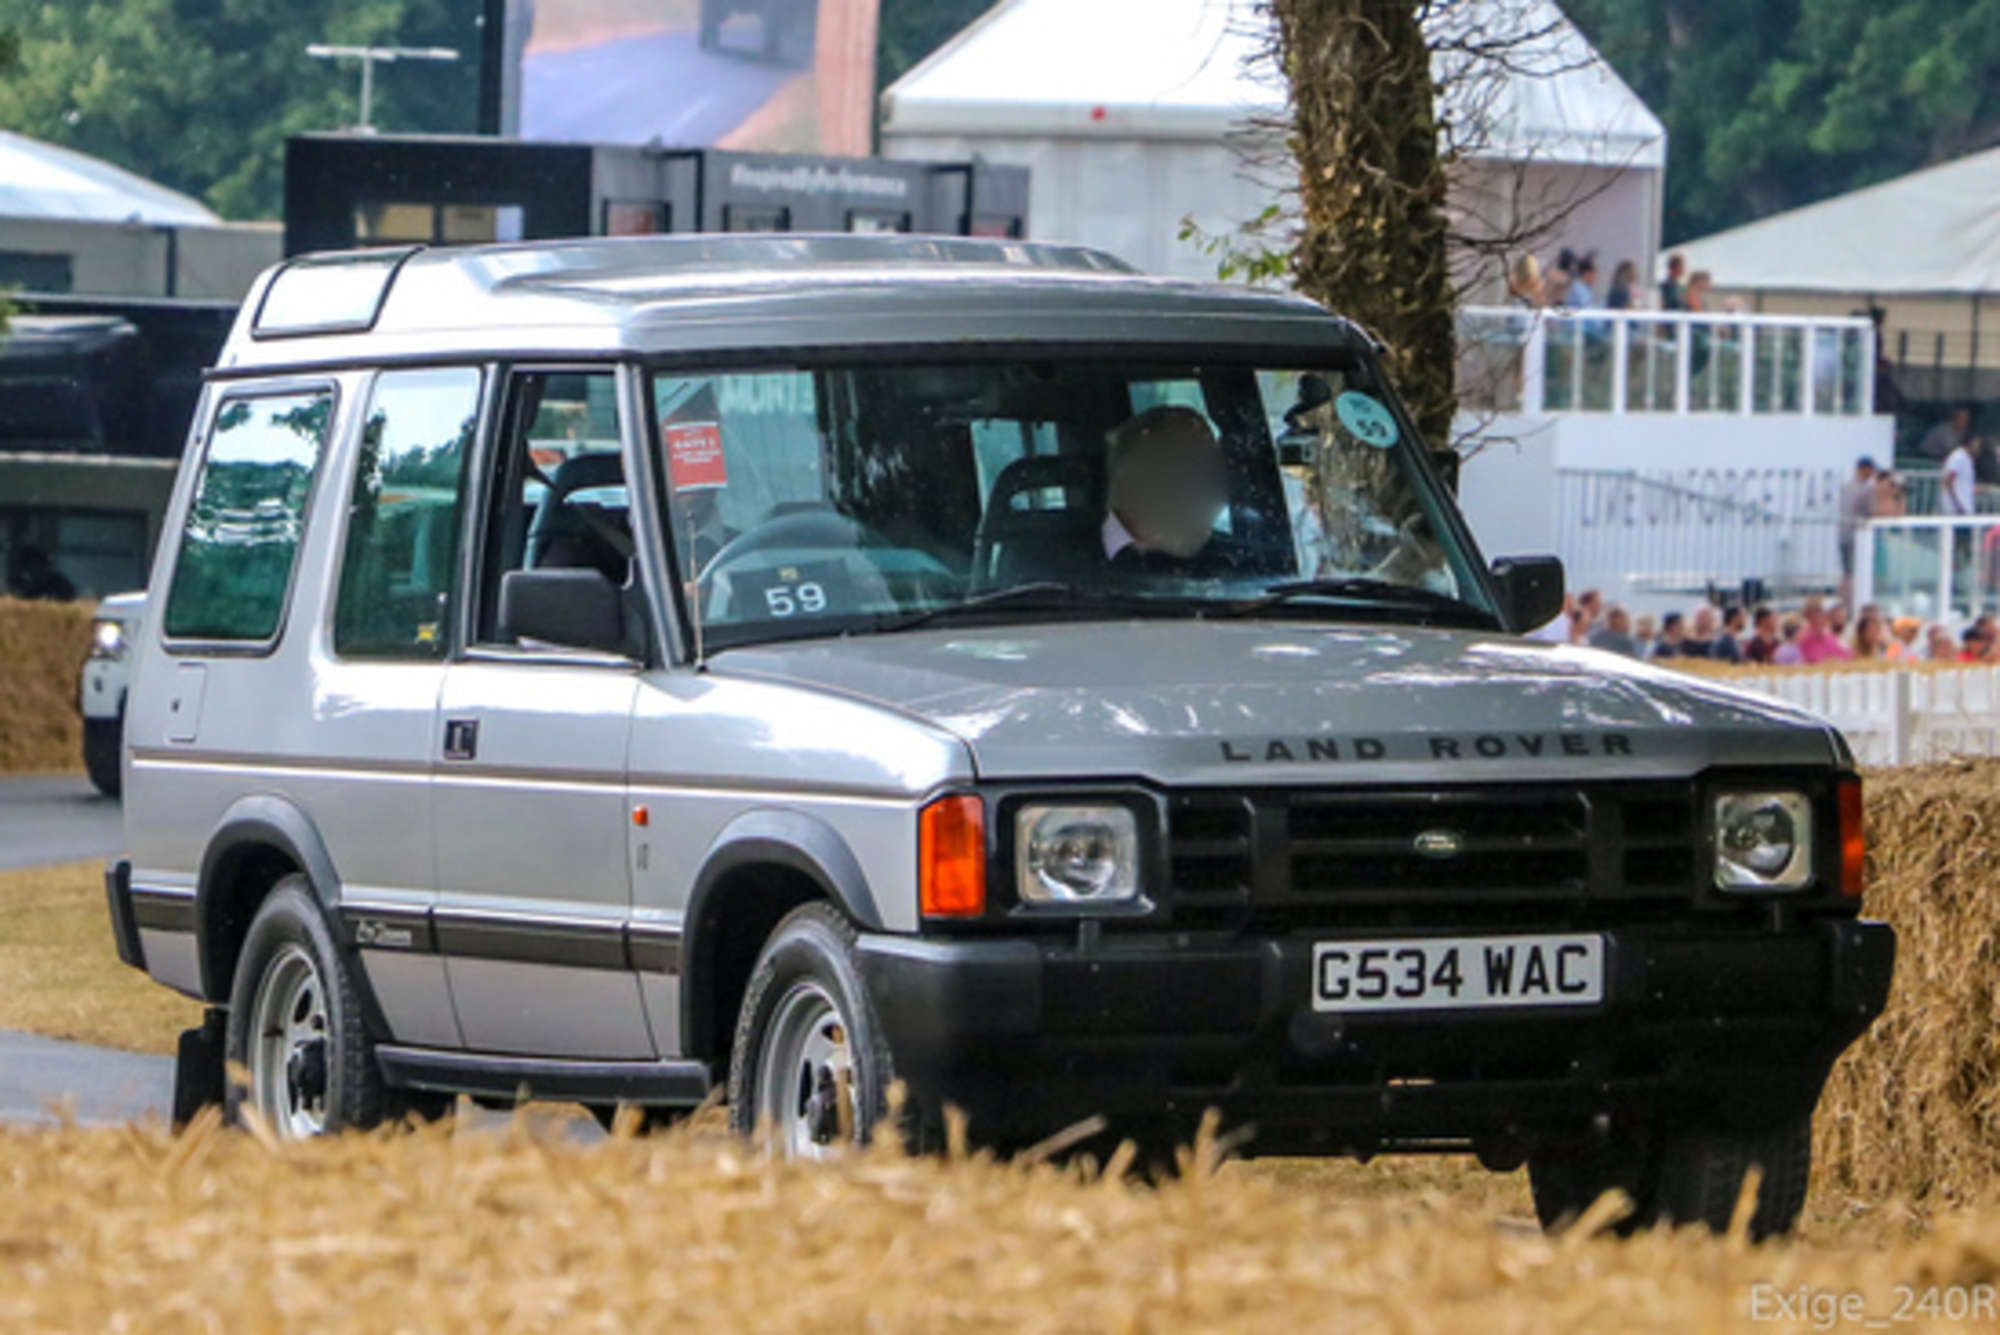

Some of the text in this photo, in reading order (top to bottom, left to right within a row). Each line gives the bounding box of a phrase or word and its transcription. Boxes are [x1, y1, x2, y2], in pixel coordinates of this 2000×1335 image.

[765, 583, 827, 617] 59
[1220, 733, 1634, 762] LAND ROVER
[1319, 945, 1588, 1001] G534 WAC
